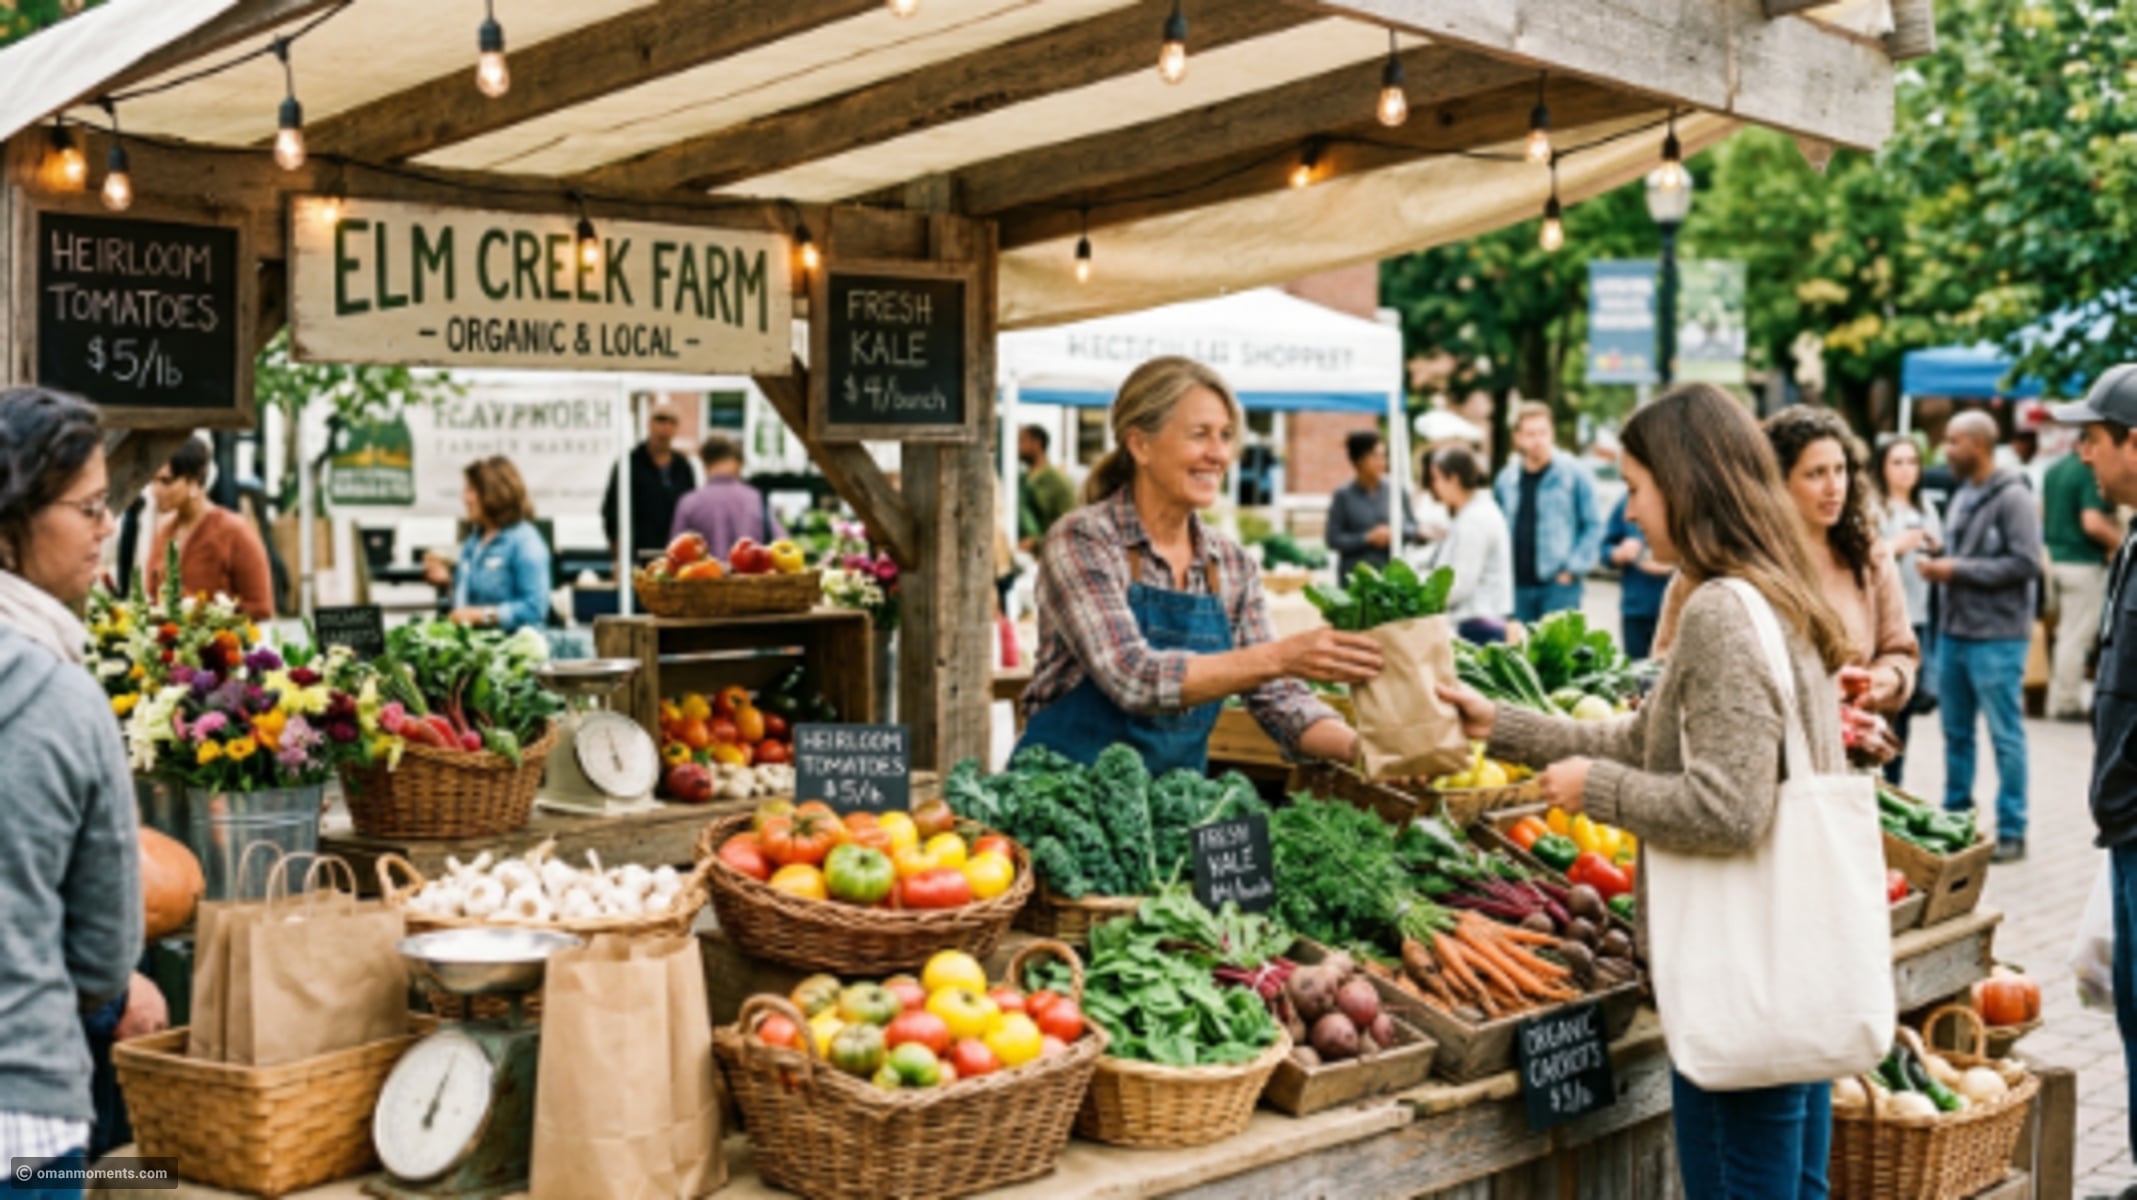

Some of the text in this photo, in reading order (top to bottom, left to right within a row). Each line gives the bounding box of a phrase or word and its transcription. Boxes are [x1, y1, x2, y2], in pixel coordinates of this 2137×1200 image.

[51, 229, 213, 284] HEIRLOOM
[334, 218, 768, 333] ELM CREEK FARM
[47, 282, 219, 333] TOMATOES
[847, 289, 933, 325] FRESH
[446, 315, 679, 358] ORGANIC & LOCAL
[850, 329, 928, 367] KALE
[801, 729, 902, 752] HEIRLOOM
[801, 754, 906, 777] TOMATOES
